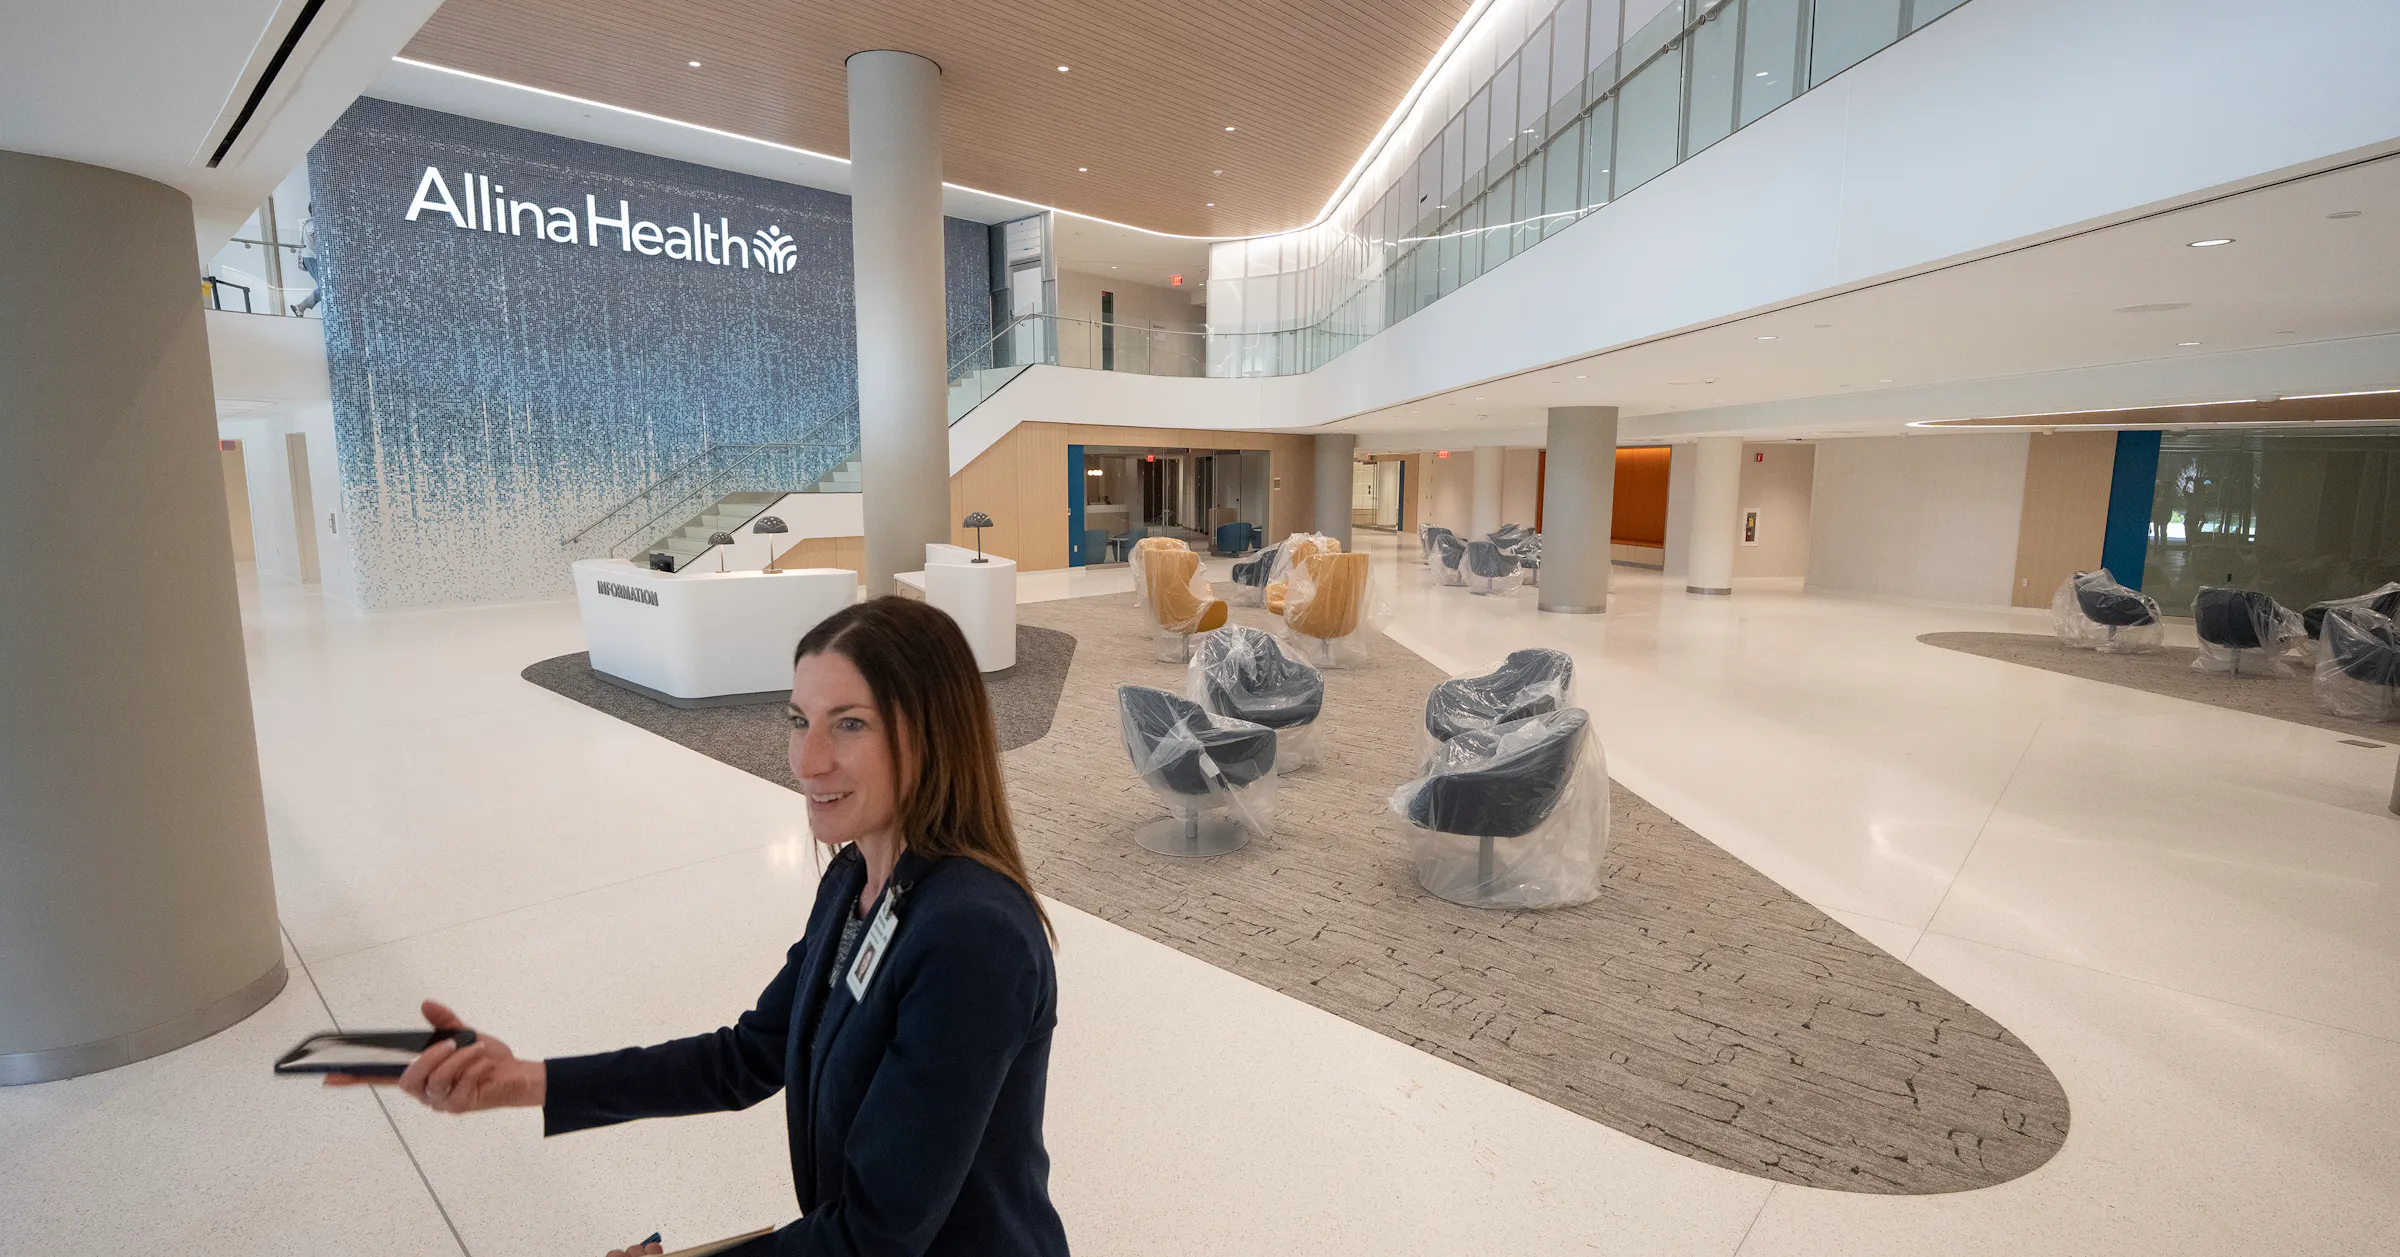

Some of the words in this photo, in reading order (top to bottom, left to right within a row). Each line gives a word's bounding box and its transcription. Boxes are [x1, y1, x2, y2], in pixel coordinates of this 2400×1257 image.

[405, 166, 579, 245] Allina
[586, 193, 749, 269] Health
[597, 580, 659, 607] INFORMATION
